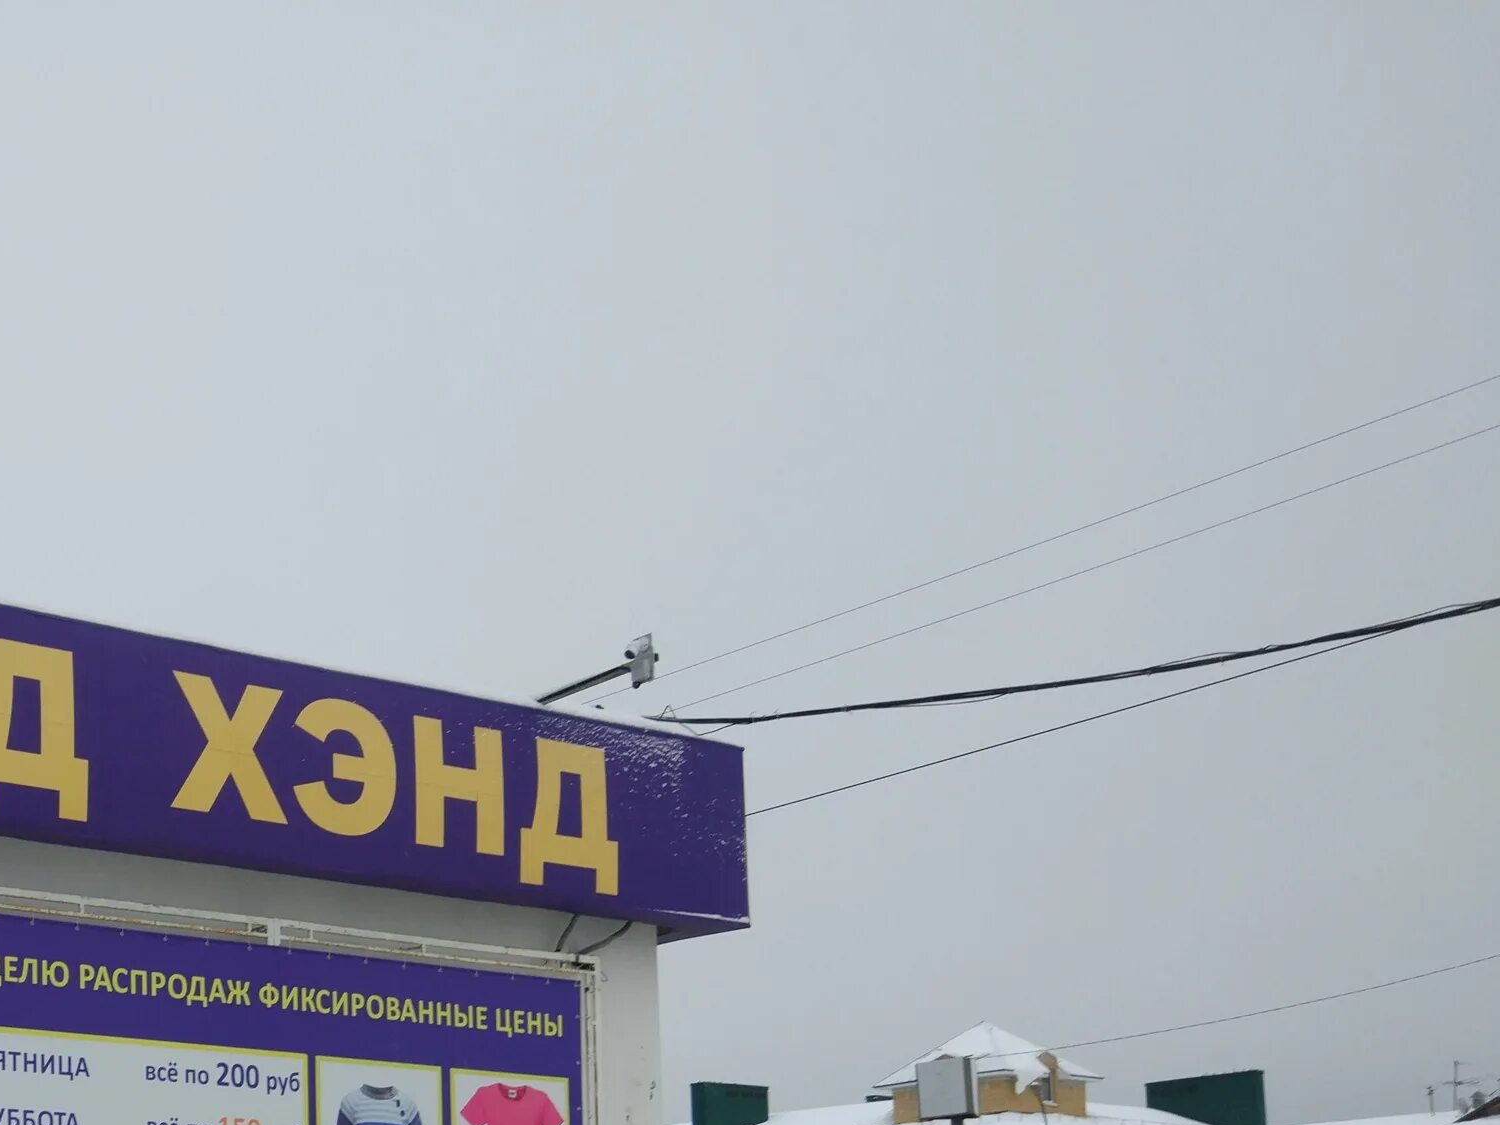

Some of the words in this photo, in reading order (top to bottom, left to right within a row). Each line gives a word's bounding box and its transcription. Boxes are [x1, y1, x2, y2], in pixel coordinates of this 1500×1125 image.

[171, 670, 618, 895] ХЭНД
[79, 964, 250, 1006] РАСПРОДАЖ
[258, 984, 487, 1030] ФИКСИРОВАННЫЕ
[496, 1009, 563, 1037] ЦЕНЫ
[146, 1063, 177, 1082] всё
[186, 1069, 209, 1084] по
[217, 1063, 259, 1088] 200
[267, 1072, 299, 1095] руб
